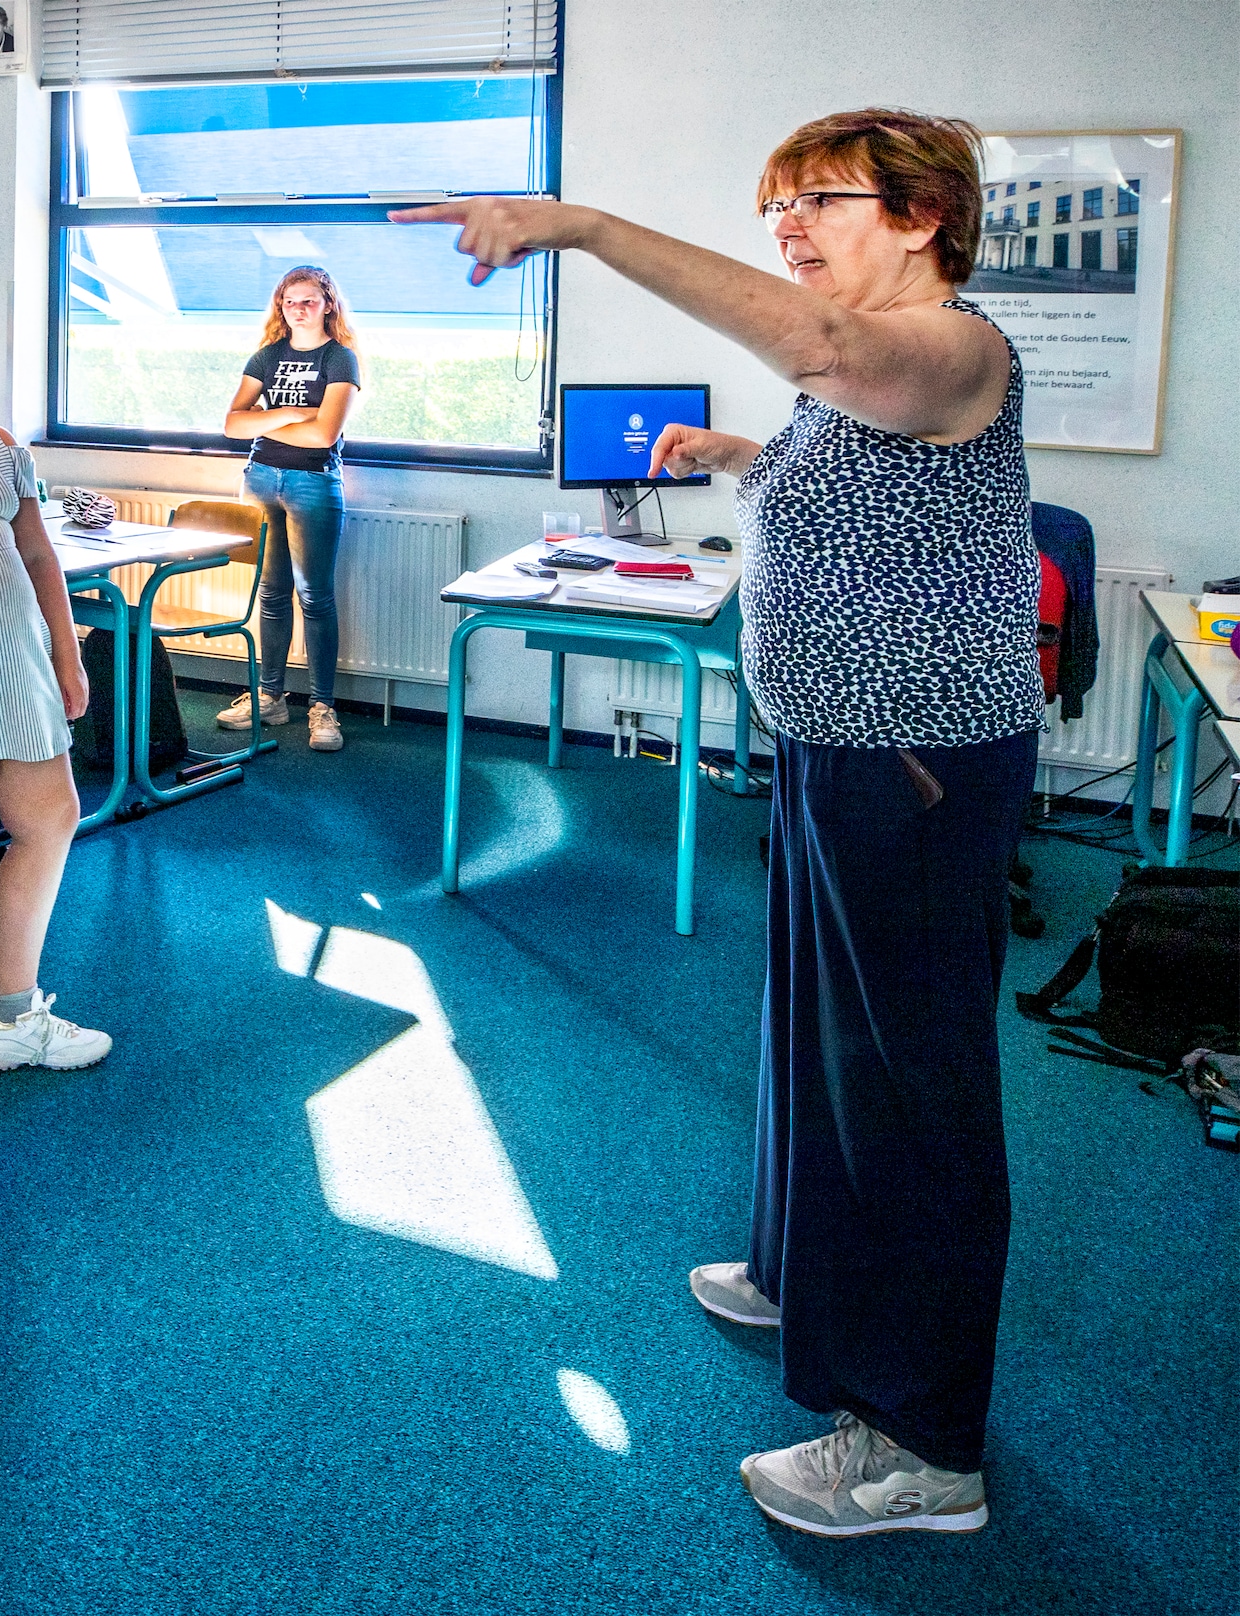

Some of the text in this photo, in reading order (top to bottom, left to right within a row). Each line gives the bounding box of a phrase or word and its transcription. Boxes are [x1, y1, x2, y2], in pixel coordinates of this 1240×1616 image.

[988, 299, 998, 307] in
[999, 299, 1012, 307] de
[1013, 299, 1032, 308] tijd,
[991, 310, 1018, 319] zullen
[1020, 310, 1039, 319] hier
[1041, 310, 1070, 320] liggen
[1072, 310, 1081, 319] in
[1083, 311, 1097, 319] de
[1030, 334, 1044, 342] tot
[1046, 334, 1059, 342] de
[1060, 334, 1099, 343] Gouden
[1101, 335, 1131, 344] Eeuw,
[274, 361, 314, 375] FEEL
[1038, 368, 1055, 378] zijn
[1072, 369, 1111, 379] bejaard,
[1030, 380, 1049, 388] hier
[1051, 380, 1095, 389] bewaard.
[267, 389, 309, 406] VIBE
